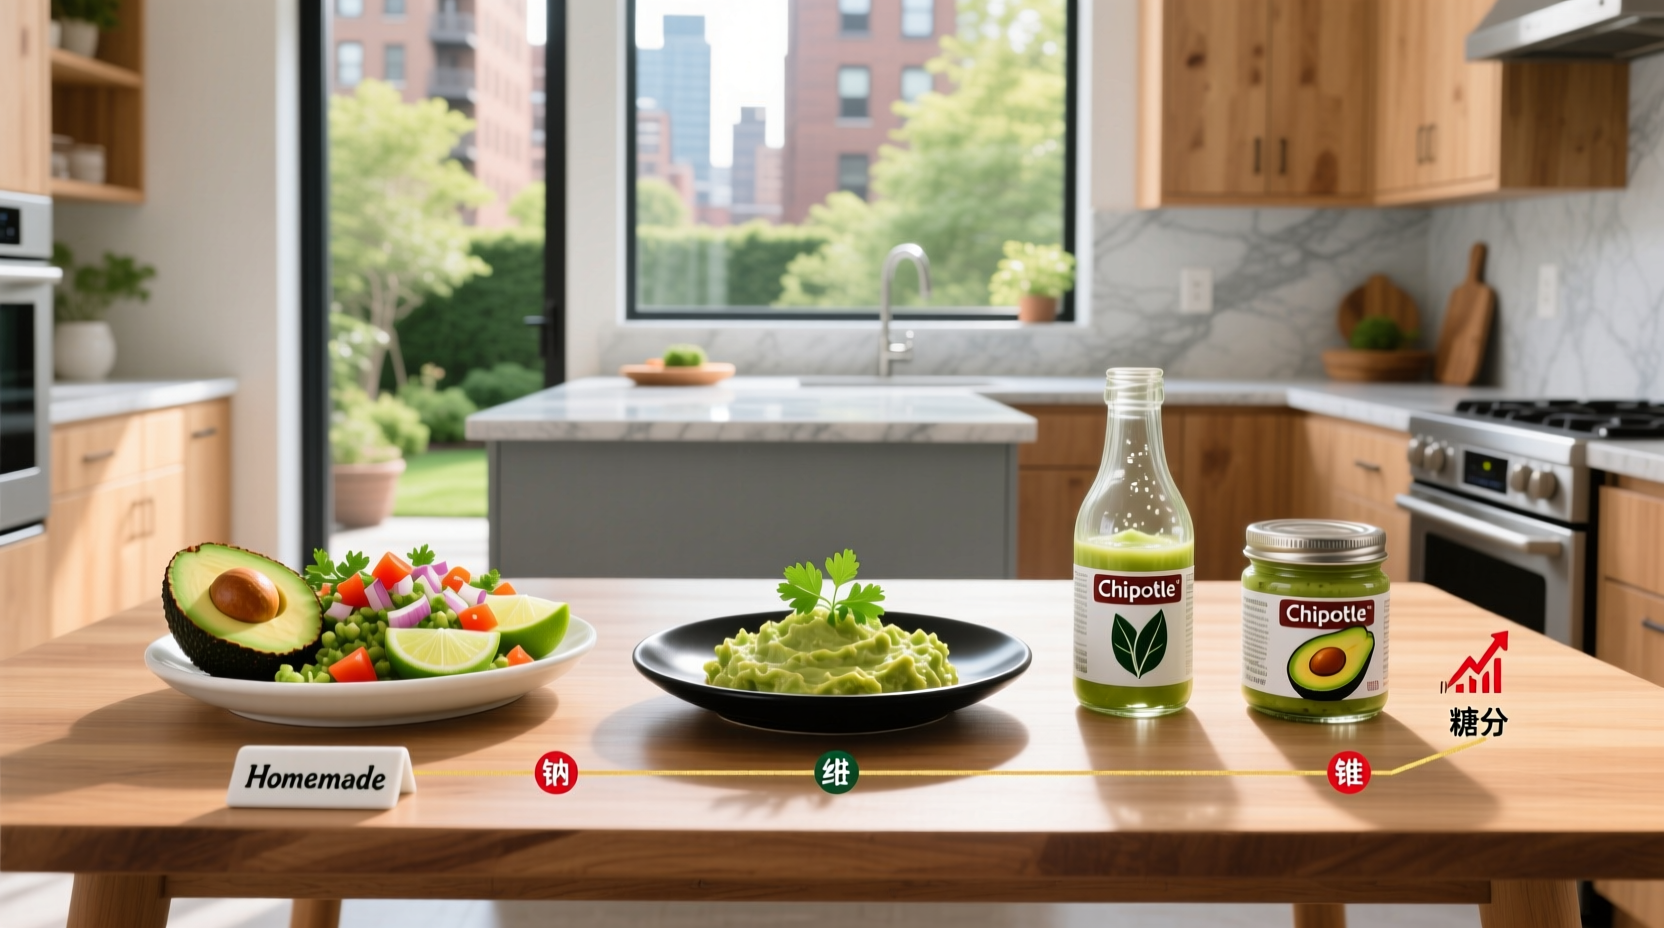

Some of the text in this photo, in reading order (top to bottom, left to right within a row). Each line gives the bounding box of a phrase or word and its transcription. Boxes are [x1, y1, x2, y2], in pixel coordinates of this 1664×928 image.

[1098, 579, 1176, 603] Chipotle
[1286, 604, 1367, 627] Chipotle
[245, 764, 386, 791] Homemade
